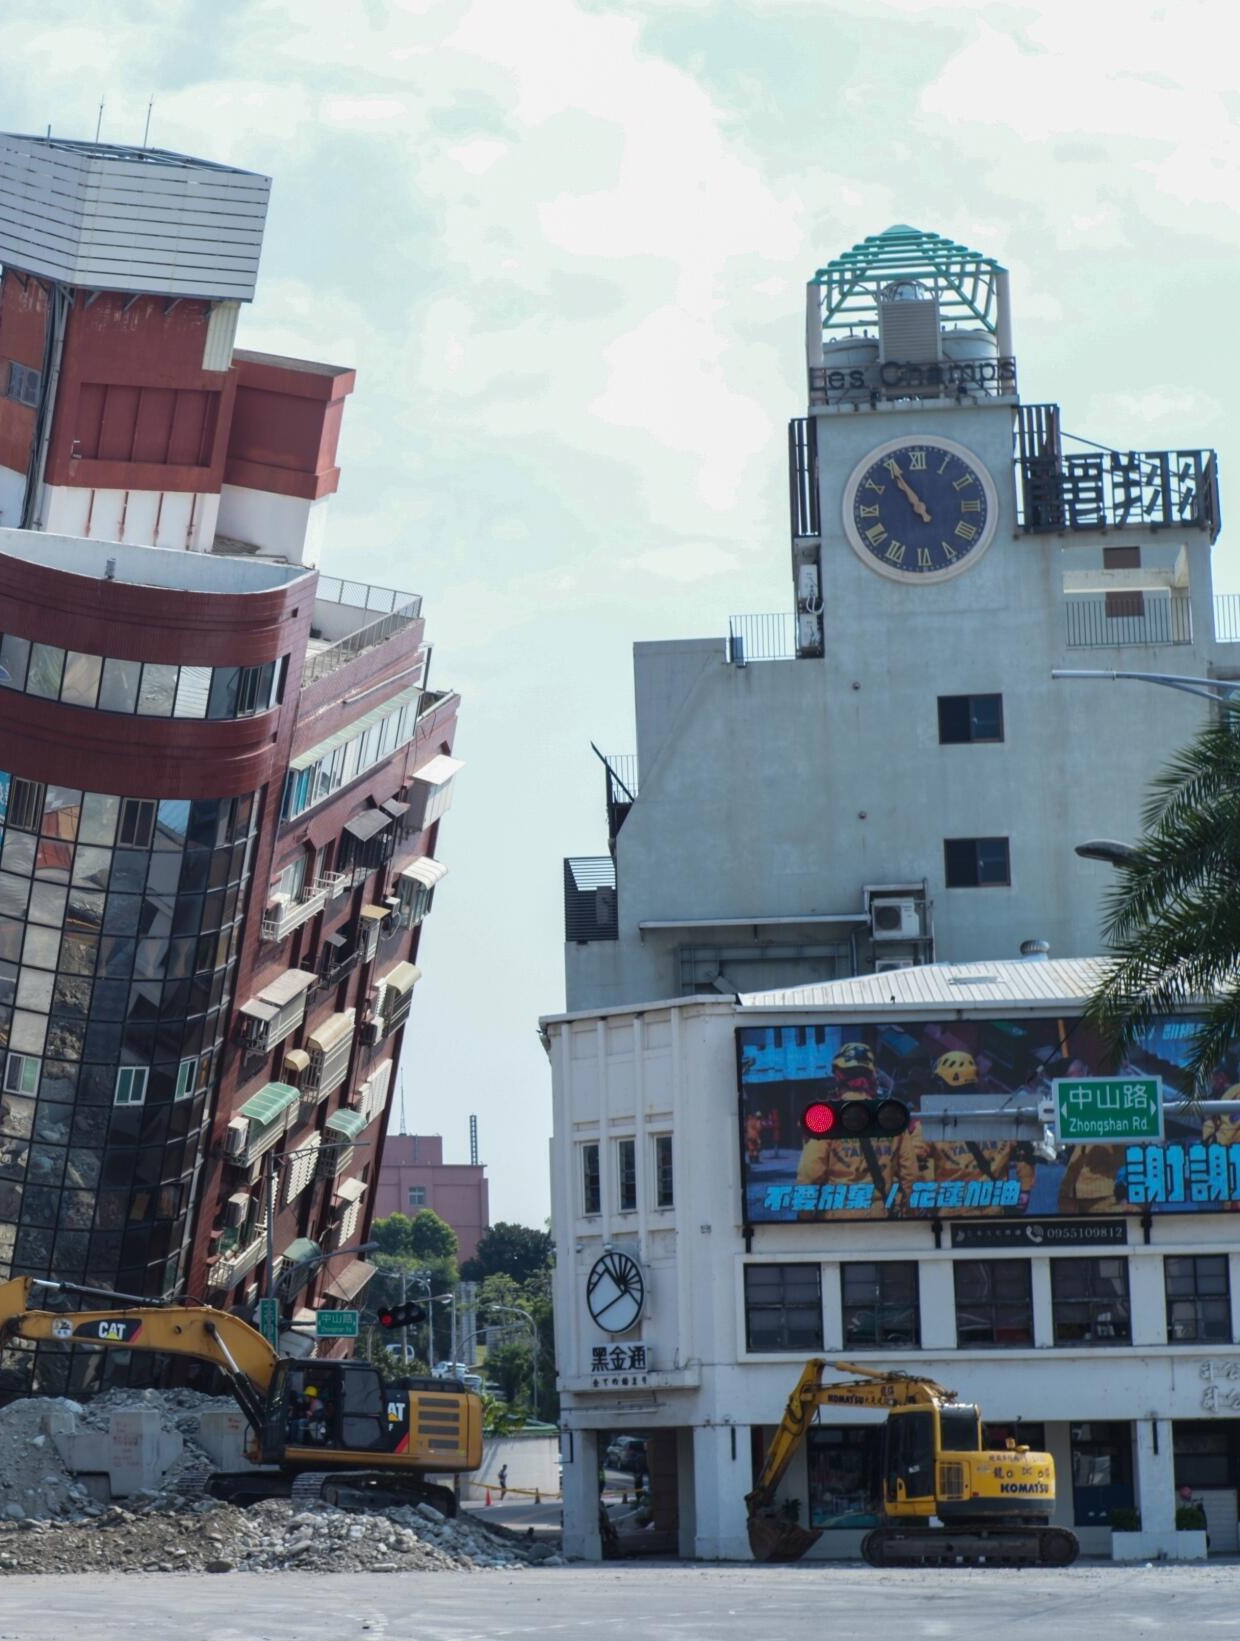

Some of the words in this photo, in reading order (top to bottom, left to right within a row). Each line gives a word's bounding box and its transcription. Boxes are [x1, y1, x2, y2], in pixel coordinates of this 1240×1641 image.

[879, 361, 1016, 388] Champs
[1069, 1084, 1148, 1110] 中山路
[1069, 1117, 1129, 1136] Zhongshan
[1133, 1116, 1148, 1130] Rd
[1126, 1143, 1240, 1204] 謝謝
[764, 1183, 875, 1212] 不要放棄
[910, 1179, 1022, 1209] 花蓮加油
[1047, 1226, 1123, 1239] 0955109812
[99, 1321, 127, 1340] CAT
[591, 1345, 647, 1372] 黑金通
[1000, 1481, 1049, 1494] KOMATSU
